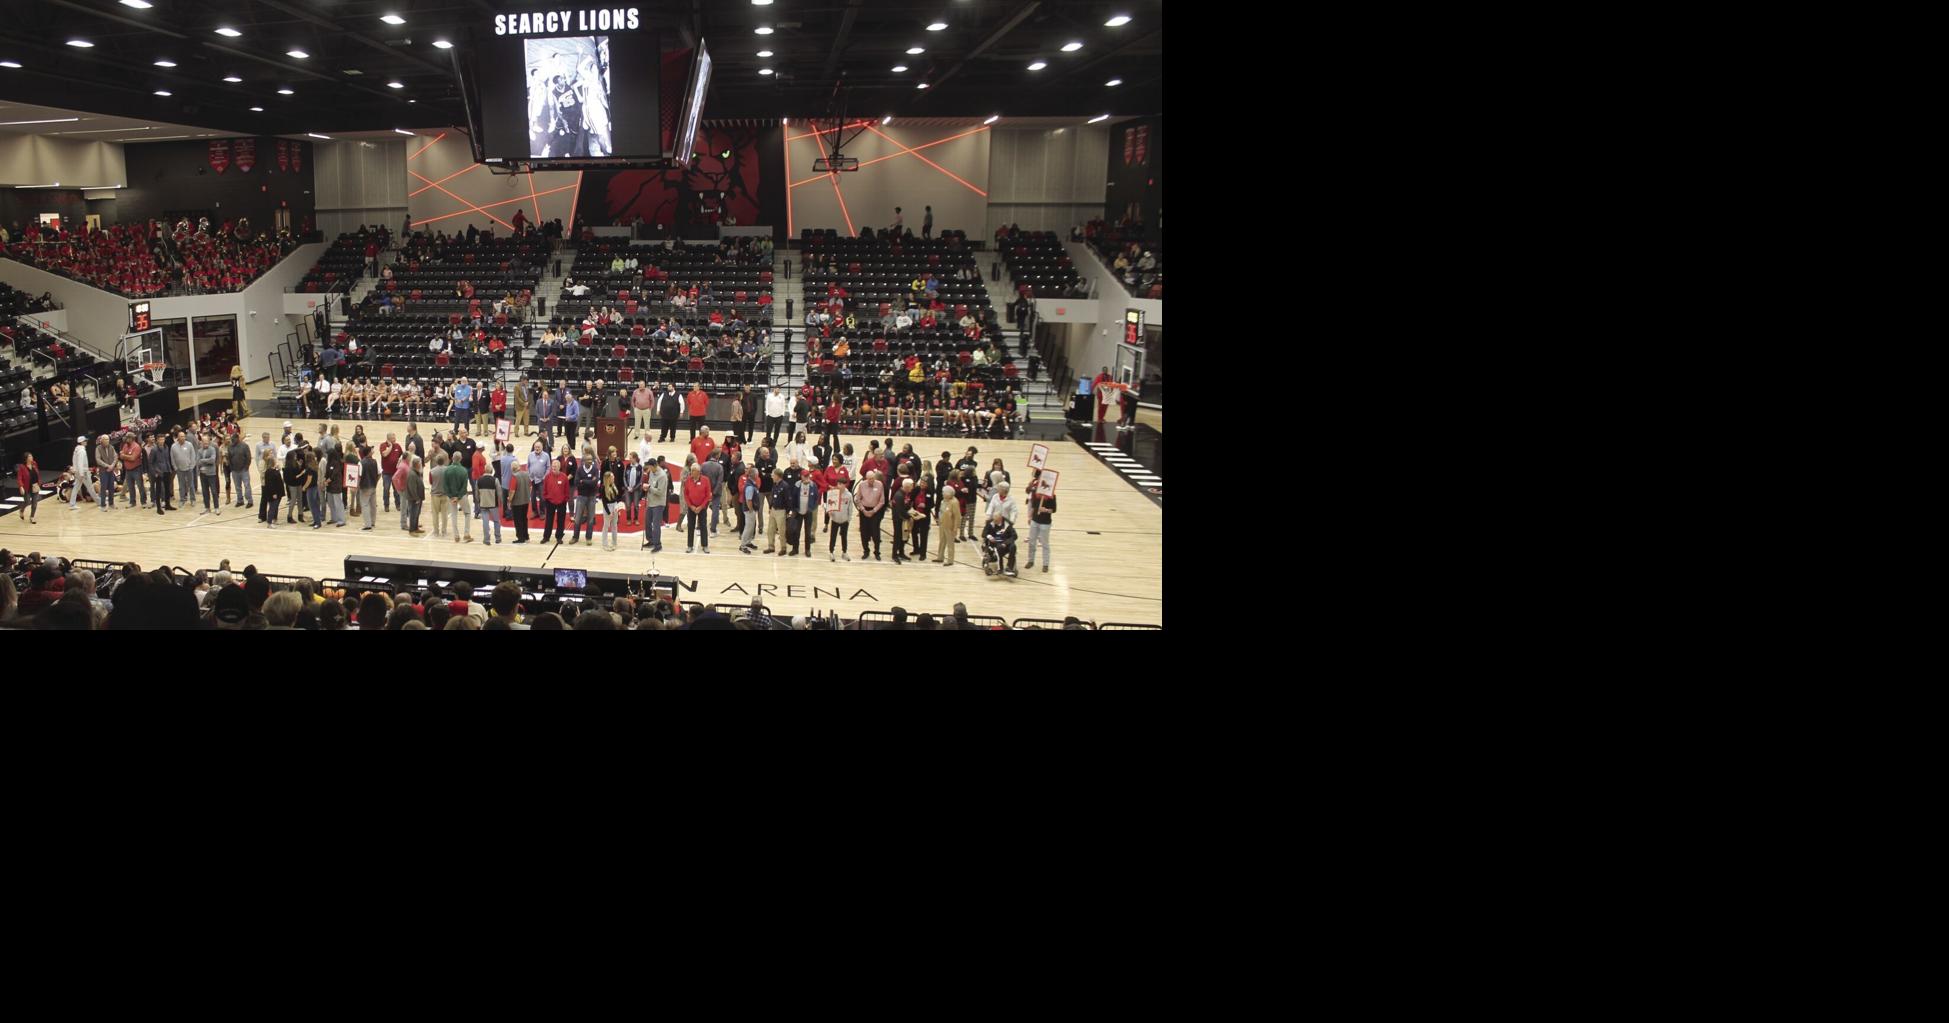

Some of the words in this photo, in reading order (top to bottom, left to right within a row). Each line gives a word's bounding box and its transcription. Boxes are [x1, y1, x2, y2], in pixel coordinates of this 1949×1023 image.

[494, 10, 572, 35] SEARCY
[579, 8, 639, 30] LIONS
[720, 581, 879, 602] ARENA
